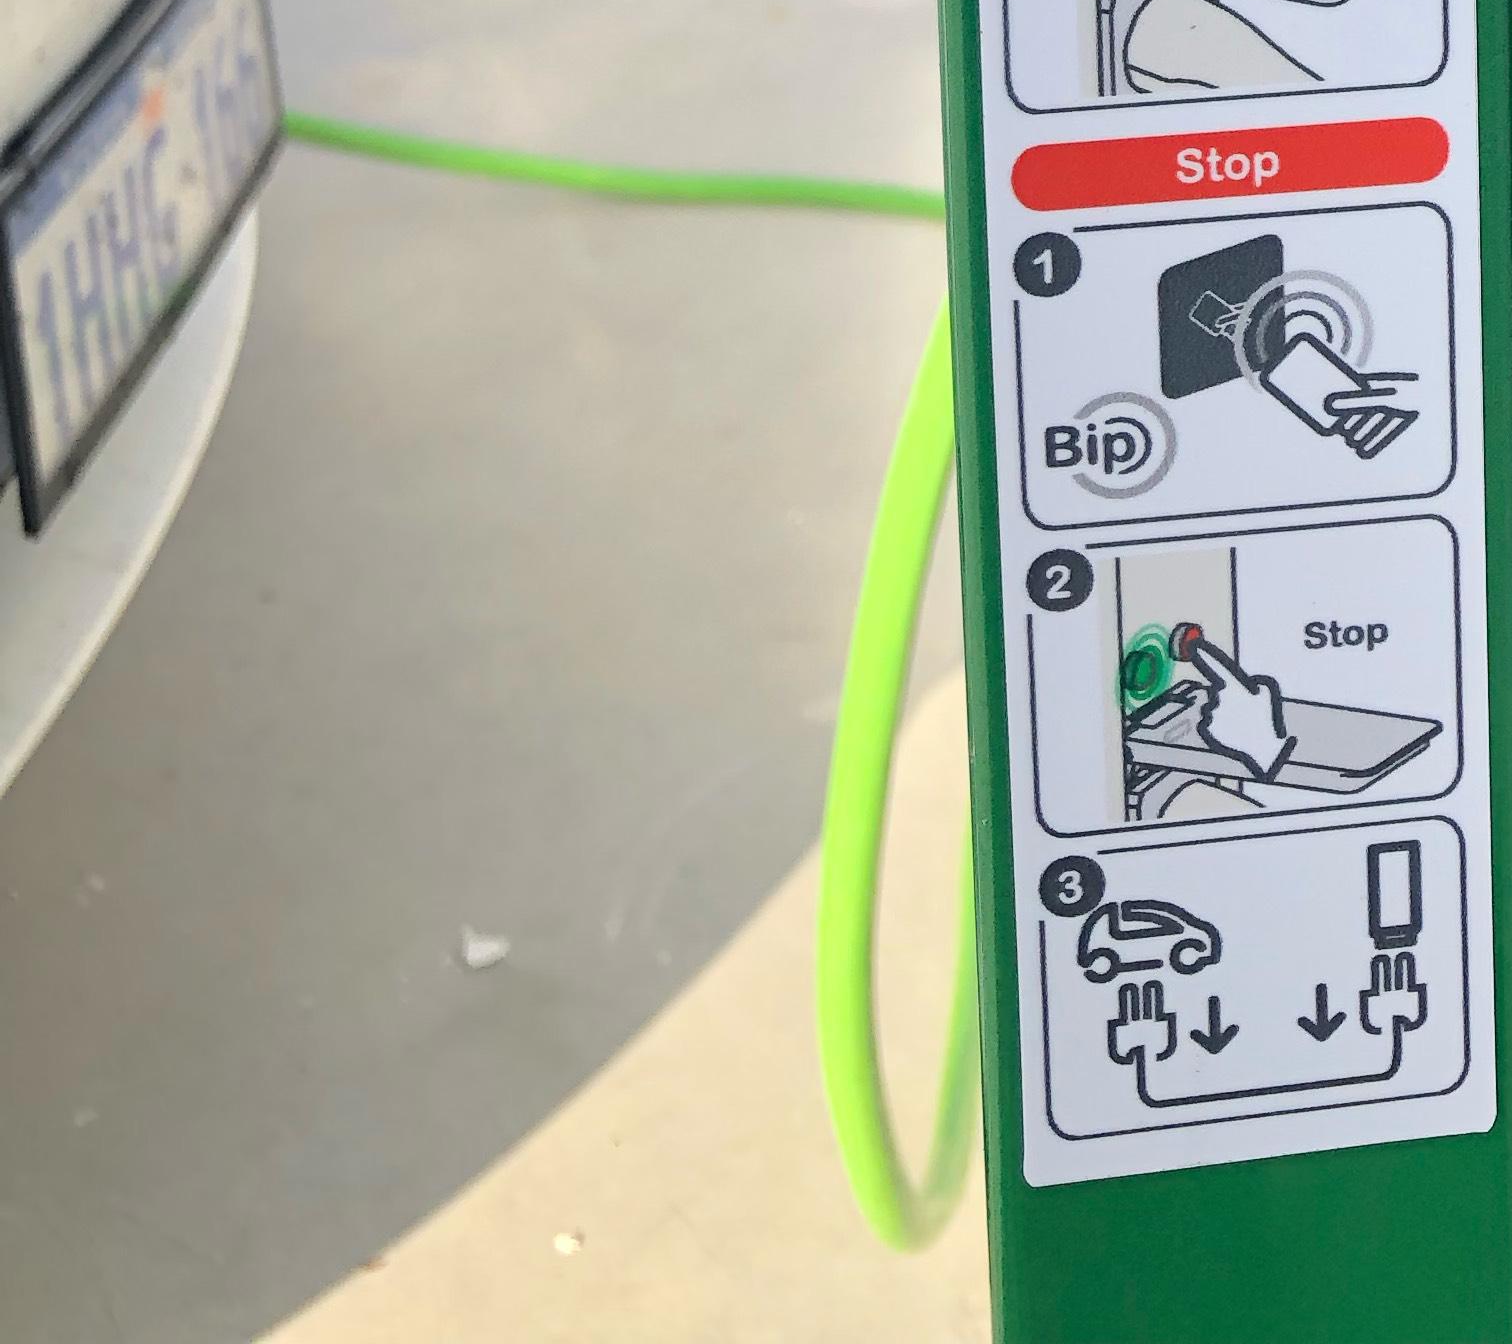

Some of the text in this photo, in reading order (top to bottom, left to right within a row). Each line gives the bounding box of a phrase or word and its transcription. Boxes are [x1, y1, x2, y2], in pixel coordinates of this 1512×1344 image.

[1176, 148, 1280, 187] Stop
[1032, 248, 1055, 285] 1
[1043, 423, 1136, 475] Bip
[1045, 564, 1072, 600] 2
[1303, 620, 1389, 652] Stop
[1057, 869, 1085, 905] 3
